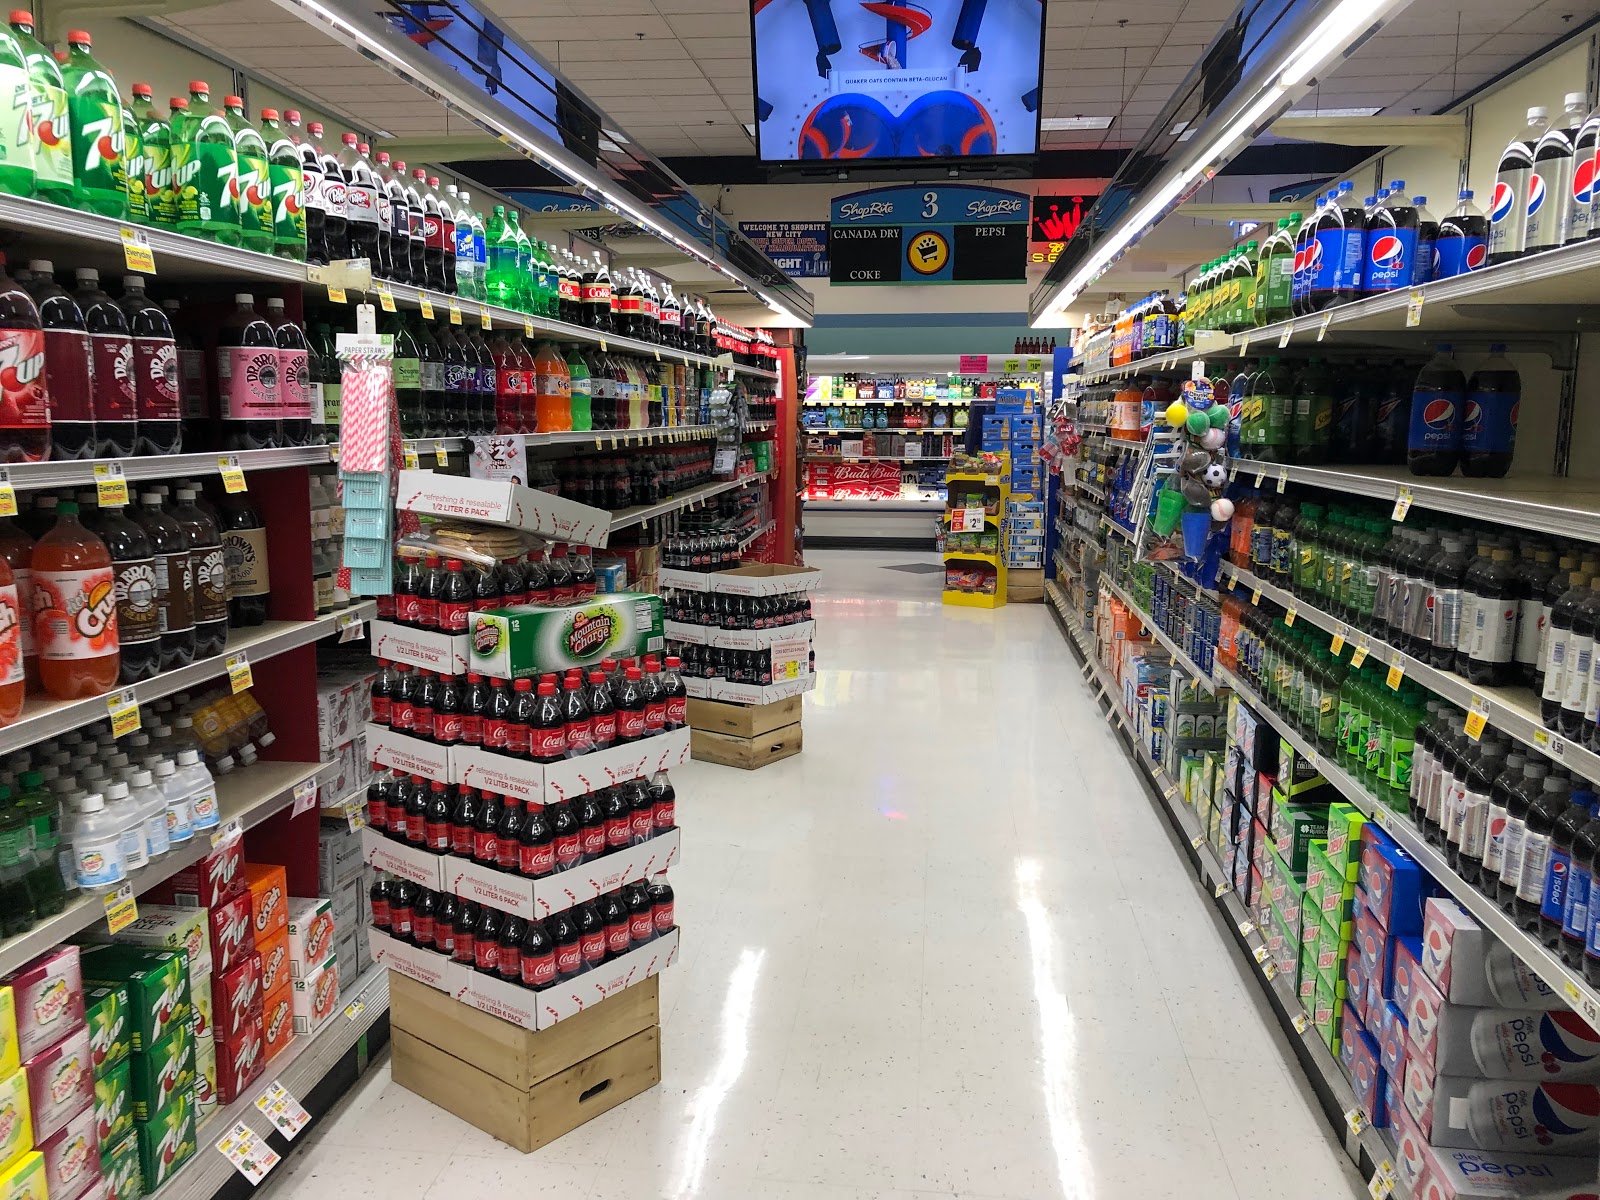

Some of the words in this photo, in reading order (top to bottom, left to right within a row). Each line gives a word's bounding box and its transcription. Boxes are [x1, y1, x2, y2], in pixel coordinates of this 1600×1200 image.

[840, 202, 894, 220] ShopRite
[922, 192, 938, 218] 3
[966, 200, 1022, 218] ShopRite
[833, 229, 878, 239] CANADA
[880, 229, 900, 238] DRY
[975, 227, 1006, 236] PEPSI
[850, 270, 881, 279] COKE
[1372, 271, 1398, 279] pepsi
[424, 493, 458, 504] refreshing
[467, 500, 501, 509] resealable
[444, 505, 463, 513] LITER
[471, 508, 490, 516] PACK
[511, 620, 519, 628] 12
[570, 616, 610, 646] Mountain
[474, 626, 498, 641] Mountain
[574, 627, 609, 653] Charge
[476, 636, 498, 650] Charge
[406, 648, 419, 657] LITER
[425, 653, 439, 662] PACK
[392, 756, 400, 765] 1/2
[401, 759, 415, 769] LITER
[420, 764, 435, 775] PACK
[476, 767, 504, 780] refreshing
[509, 775, 538, 788] resealable
[484, 777, 492, 785] 1/2
[493, 779, 508, 789] LITER
[514, 784, 530, 795] PACK
[474, 886, 482, 895] 1/2
[483, 889, 498, 900] LITER
[504, 896, 519, 908] PACK
[1552, 876, 1562, 905] pepsi
[256, 886, 280, 931] Crush
[288, 925, 297, 933] 12
[308, 918, 328, 958] Crush
[168, 933, 177, 944] 12
[263, 946, 285, 990] Crush
[316, 972, 334, 1014] Crush
[477, 1000, 485, 1010] 1/2
[486, 1005, 502, 1016] LITER
[508, 1012, 523, 1024] PACK
[267, 1002, 288, 1044] Crush
[1509, 1018, 1539, 1066] pepsi
[1503, 1092, 1528, 1139] pepsi
[1458, 1161, 1553, 1178] pepsi
